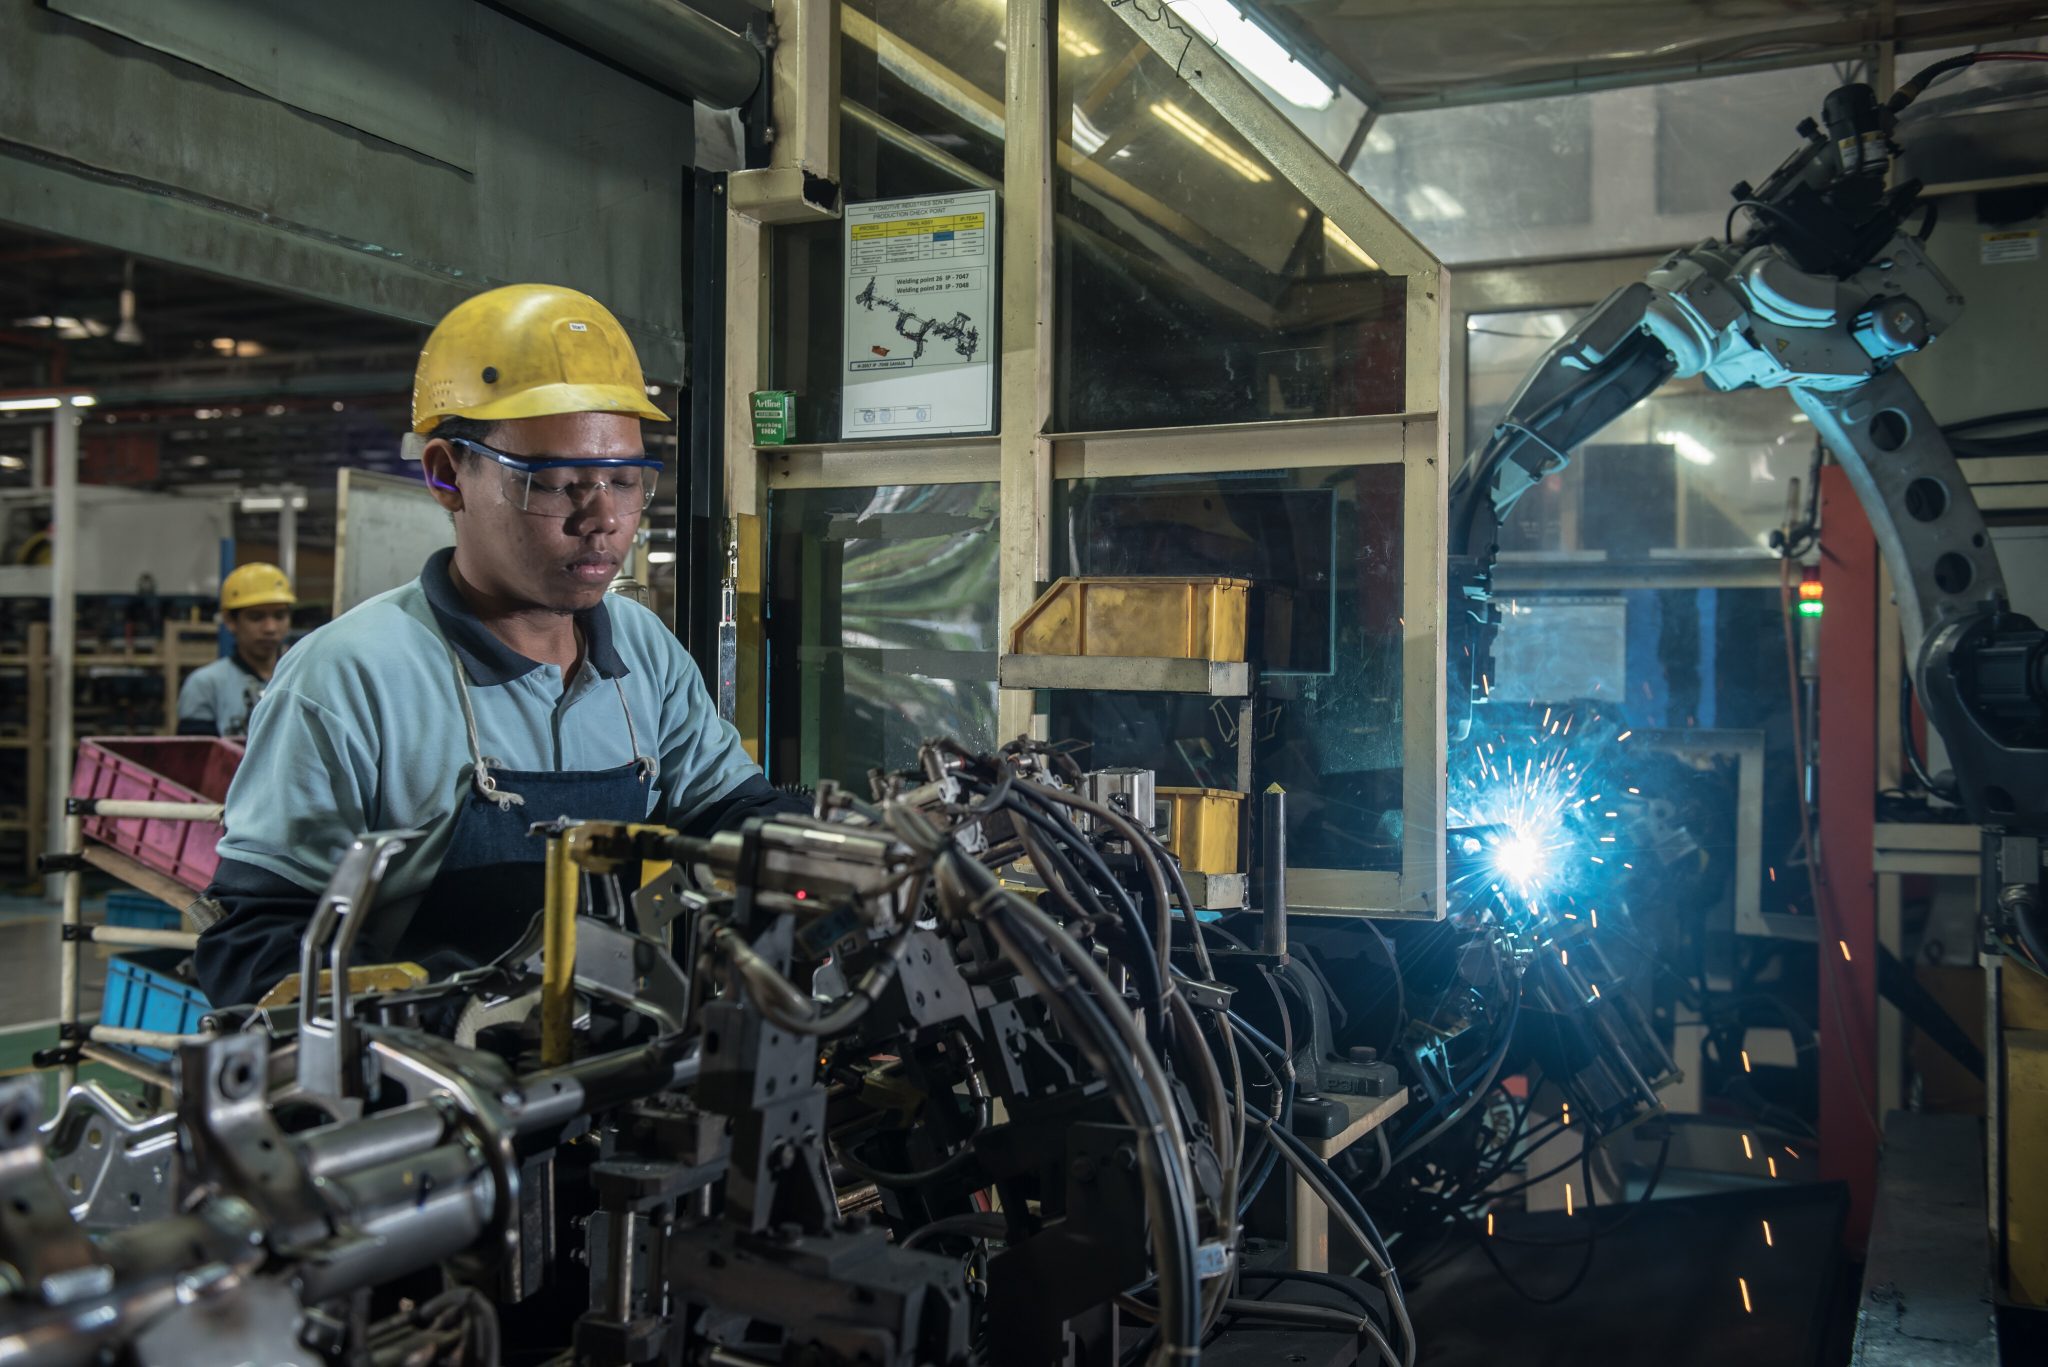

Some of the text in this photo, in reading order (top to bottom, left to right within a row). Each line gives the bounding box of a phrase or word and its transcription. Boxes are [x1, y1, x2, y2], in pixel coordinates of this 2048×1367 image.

[873, 211, 909, 220] PRODUCTION
[896, 278, 919, 286] Welding
[919, 276, 935, 284] point
[896, 286, 919, 294] Welding
[919, 285, 935, 293] point
[755, 399, 781, 408] Artline
